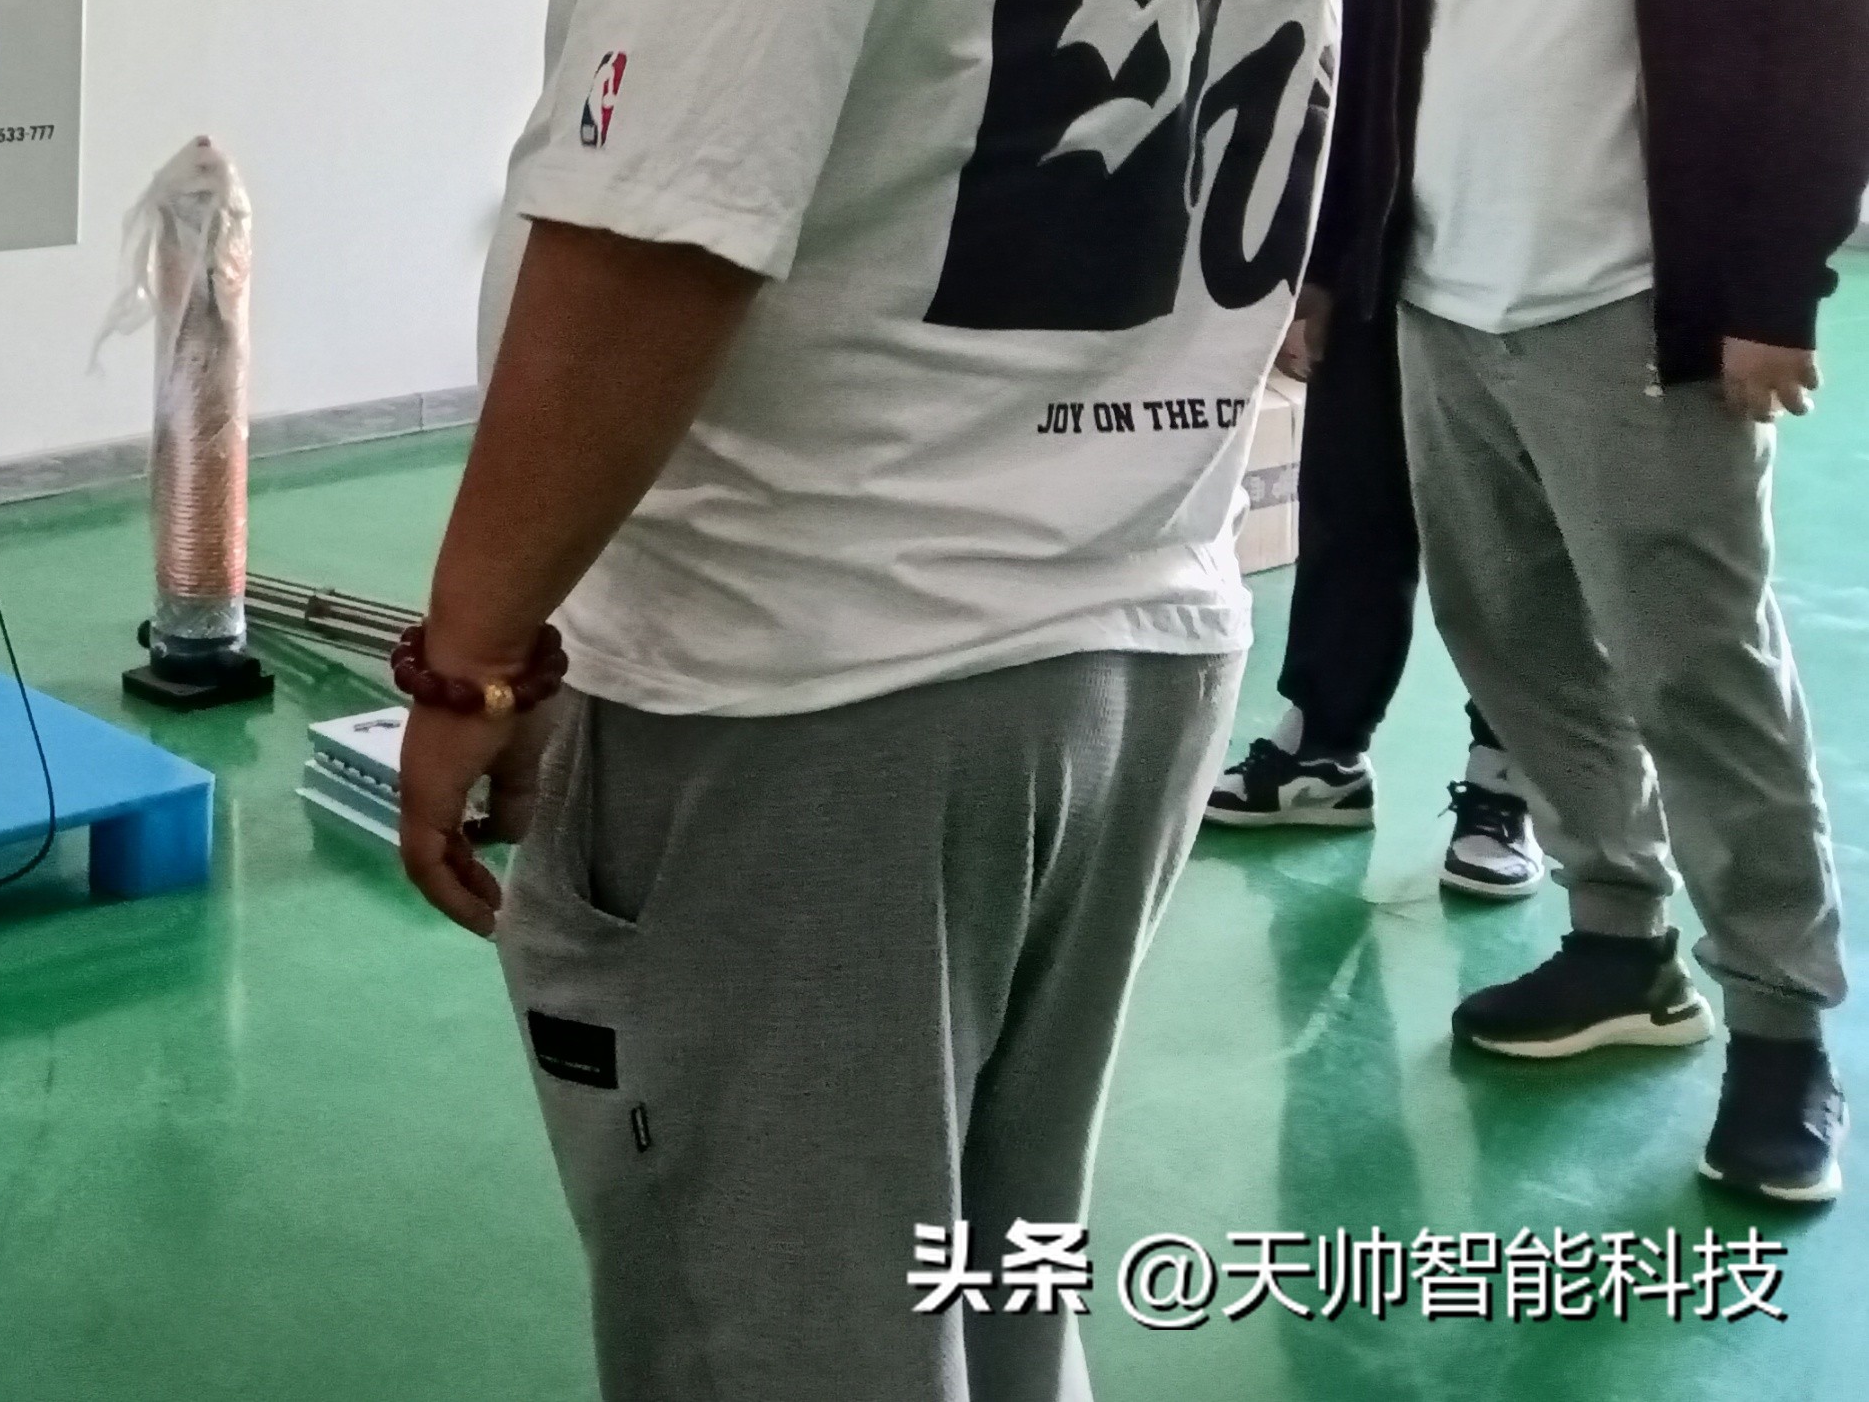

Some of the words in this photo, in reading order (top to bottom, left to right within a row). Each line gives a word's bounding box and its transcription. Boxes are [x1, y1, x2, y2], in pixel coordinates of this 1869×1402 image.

[1037, 402, 1084, 434] JOY
[1093, 401, 1135, 433] ON
[1143, 398, 1209, 431] THE
[1216, 398, 1250, 429] CO
